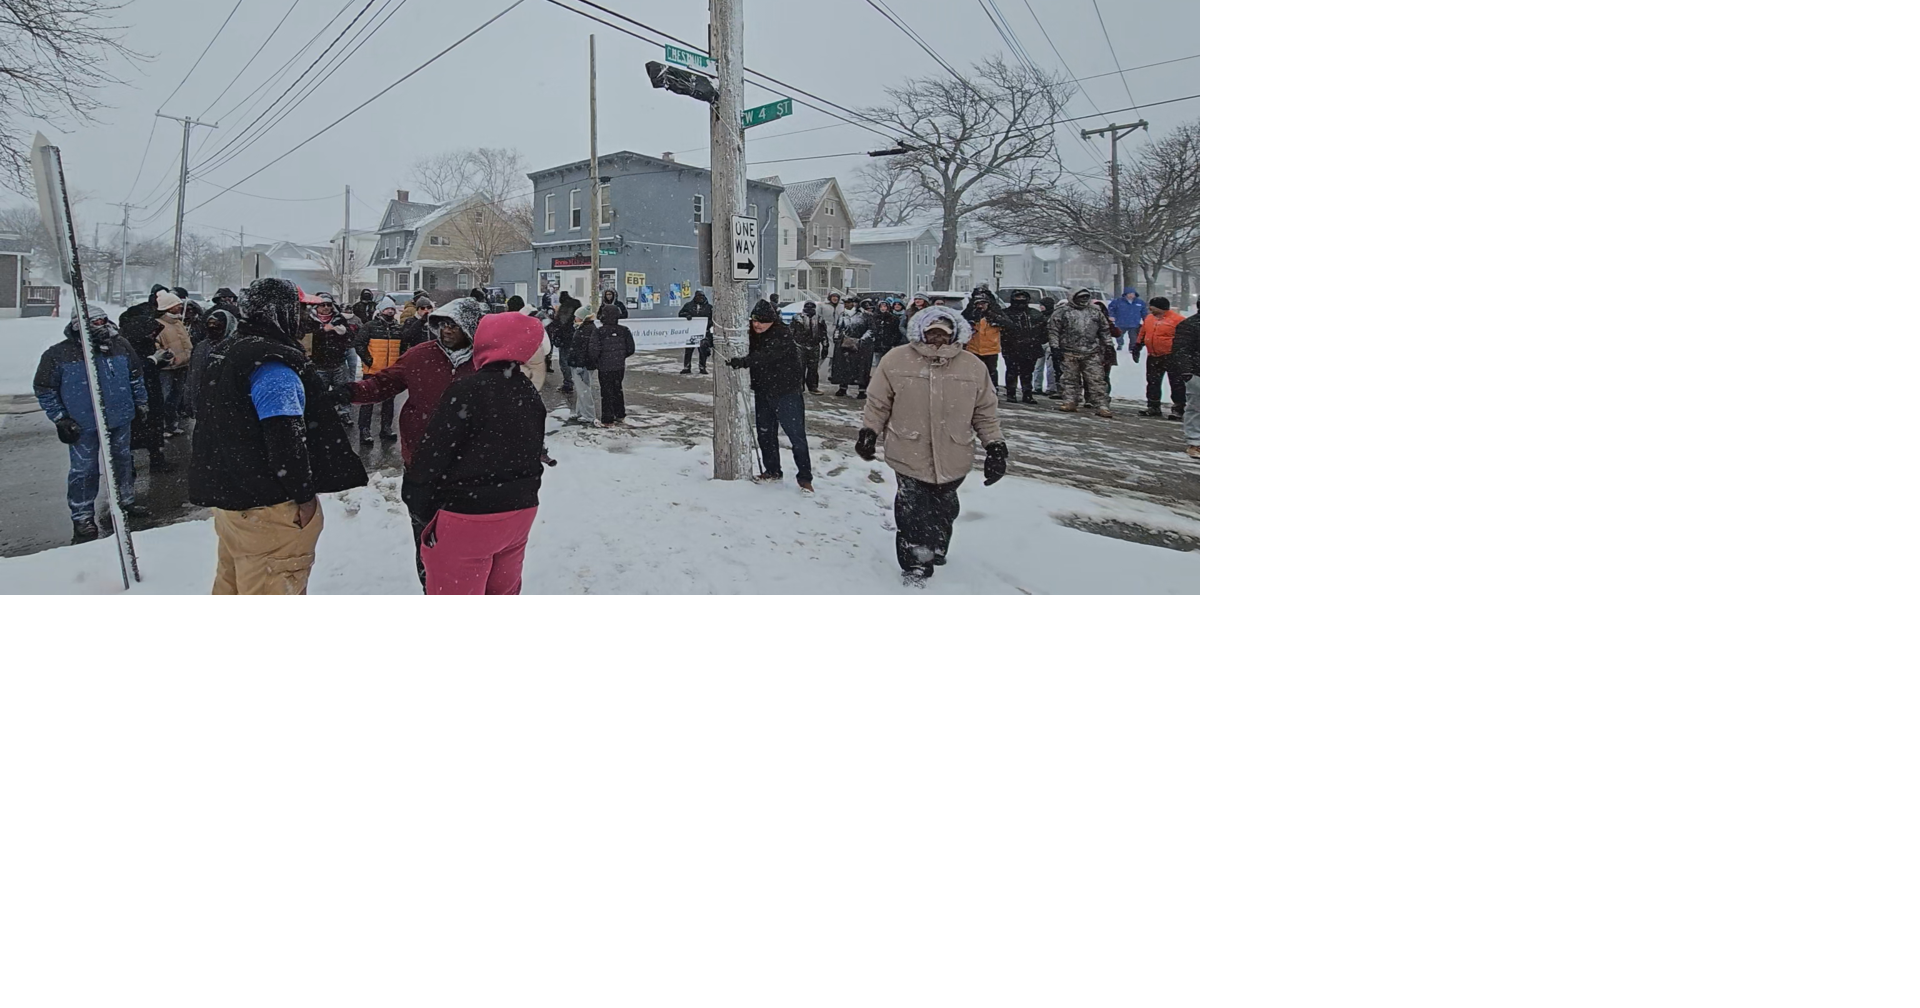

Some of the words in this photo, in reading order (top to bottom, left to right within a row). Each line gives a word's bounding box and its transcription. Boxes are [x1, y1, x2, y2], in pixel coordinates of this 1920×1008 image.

[745, 110, 754, 124] W
[758, 107, 766, 119] 4
[776, 101, 790, 116] ST
[735, 221, 755, 237] ONE
[735, 239, 756, 254] WAY
[626, 276, 645, 285] EBT
[640, 329, 668, 337] Advisory
